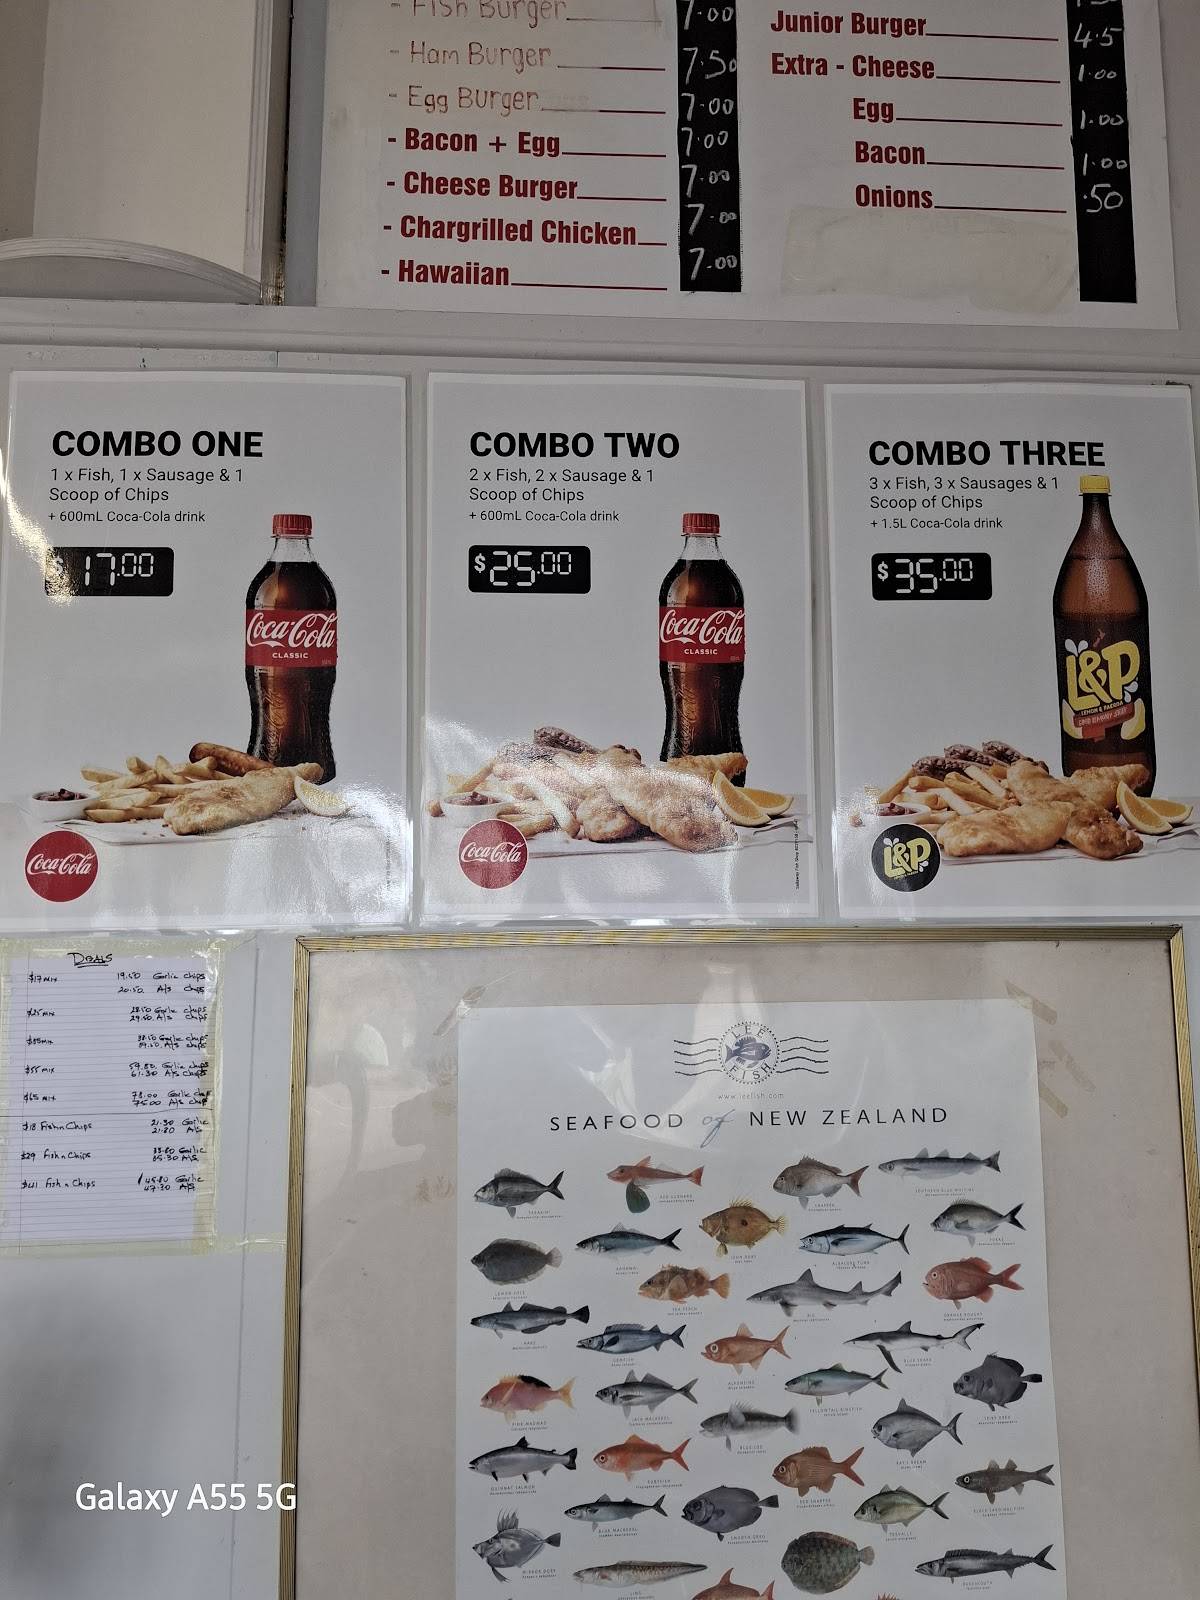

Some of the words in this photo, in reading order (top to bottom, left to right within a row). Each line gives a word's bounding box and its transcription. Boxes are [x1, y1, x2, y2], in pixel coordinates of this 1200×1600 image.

[771, 10, 843, 34] Junior
[851, 12, 927, 38] Burger
[410, 40, 460, 65] Ham
[468, 42, 551, 74] Burger
[771, 52, 828, 76] Extra
[852, 55, 935, 79] Cheese
[408, 85, 449, 114] Egg
[458, 86, 538, 117] Burger
[853, 98, 894, 123] Egg
[404, 127, 478, 153] Bacon
[488, 135, 507, 153] +
[518, 131, 561, 157] Egg
[855, 141, 926, 165] Bacon
[403, 171, 491, 197] Cheese
[499, 174, 578, 201] Burger
[855, 184, 933, 209] Onions
[399, 214, 533, 242] Chargrilled
[541, 220, 637, 246] Chicken
[398, 259, 510, 286] Hawaiian
[52, 429, 181, 457] COMBO
[191, 430, 264, 458] ONE
[469, 431, 594, 458] COMBO
[603, 432, 680, 459] TWO
[868, 440, 991, 467] COMBO
[999, 440, 1106, 467] THREE
[50, 468, 58, 481] 1
[64, 471, 73, 481] x
[78, 467, 115, 484] Fish,
[120, 468, 127, 481] 1
[133, 471, 142, 481] x
[146, 467, 215, 484] Sausage
[219, 468, 231, 482] &
[235, 468, 243, 482] 1
[469, 468, 479, 481] 2
[483, 472, 492, 481] x
[496, 467, 531, 484] Fish,
[535, 468, 545, 482] 2
[549, 472, 558, 482] x
[562, 468, 627, 485] Sausage
[631, 469, 643, 483] &
[646, 469, 654, 482] 1
[869, 477, 878, 490] 3
[883, 481, 891, 490] x
[895, 477, 931, 492] Fish,
[934, 477, 943, 490] 3
[947, 481, 956, 489] x
[960, 477, 1033, 492] Sausages
[1037, 477, 1048, 490] &
[1051, 477, 1058, 490] 1
[49, 487, 99, 504] Scoop
[104, 487, 121, 501] of
[125, 487, 169, 504] Chips
[469, 487, 517, 503] Scoop
[522, 487, 538, 501] of
[542, 488, 584, 504] Chips
[870, 496, 917, 512] Scoop
[921, 495, 937, 509] of
[941, 495, 983, 511] Chips
[59, 511, 103, 522] 600mL
[107, 511, 171, 522] Coca-Cola
[174, 510, 206, 522] drink
[480, 510, 522, 521] 600mL
[525, 510, 587, 522] Coca-Cola
[590, 510, 620, 522] drink
[881, 518, 907, 529] 1.5L
[910, 518, 970, 529] Coca-Cola
[973, 517, 1003, 529] drink
[246, 611, 339, 649] Coca-Cola
[659, 608, 746, 645] Coca-Cola
[271, 651, 309, 659] CLASSIC
[1065, 640, 1141, 711] L&P
[26, 852, 97, 876] Coca-Cola
[460, 841, 526, 863] Coca-Cola
[883, 837, 931, 878] L&P
[731, 1025, 766, 1039] LEE
[729, 1063, 772, 1080] FISH
[549, 1113, 684, 1132] SEAFOOD
[701, 1108, 735, 1148] of
[749, 1109, 808, 1127] NEW
[822, 1106, 948, 1125] ZEALAND
